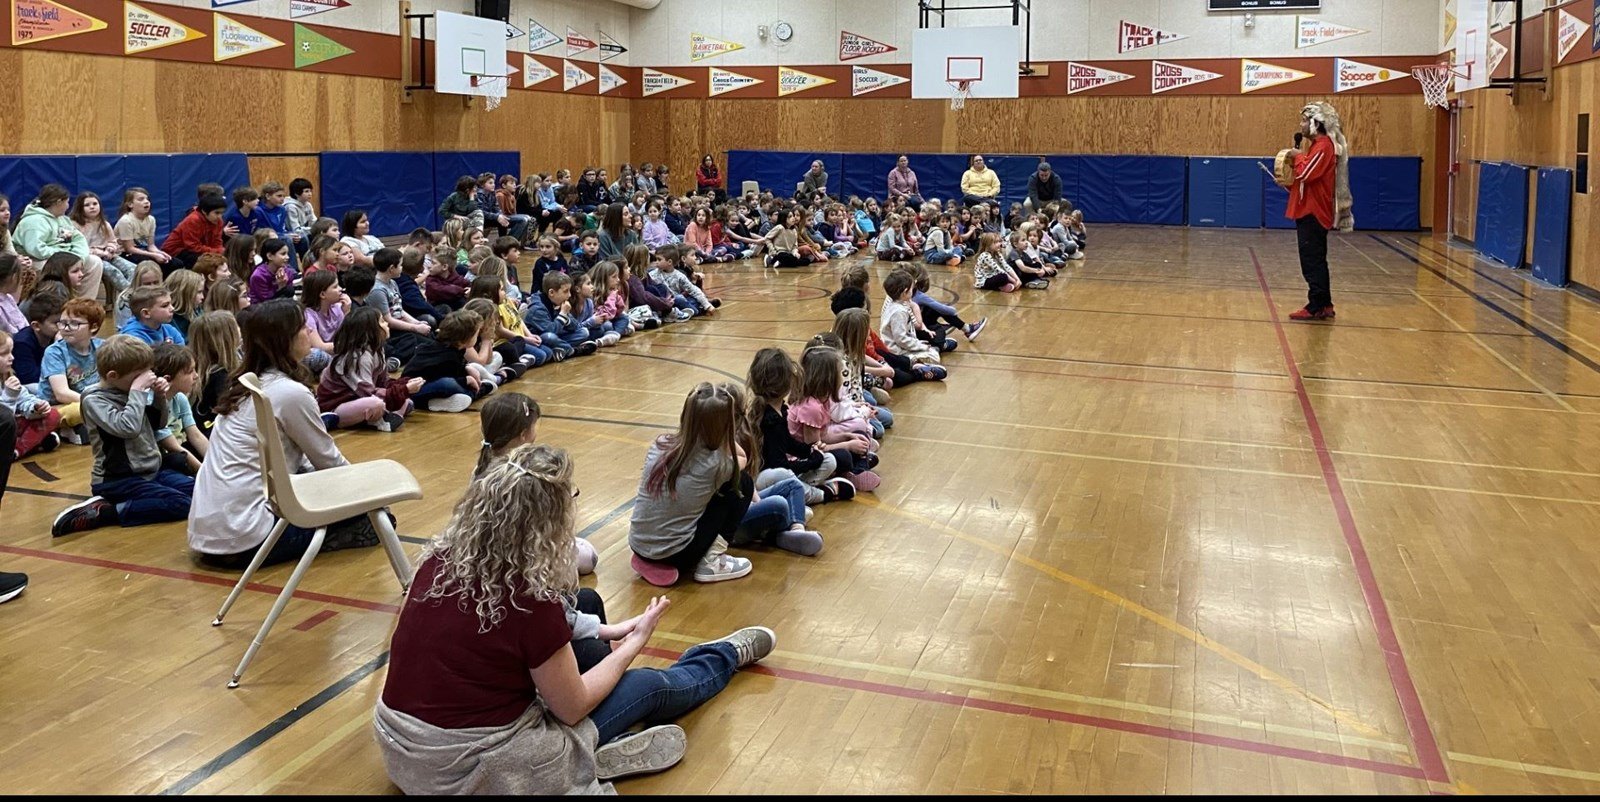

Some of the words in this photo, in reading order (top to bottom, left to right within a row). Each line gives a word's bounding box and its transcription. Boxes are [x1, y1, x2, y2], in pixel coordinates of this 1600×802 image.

[129, 22, 171, 38] SOCCER
[1124, 22, 1153, 36] TRACK
[693, 43, 728, 52] BASKETBALL
[1127, 37, 1153, 50] FIELD
[1070, 64, 1096, 78] CROSS
[1155, 63, 1182, 77] CROSS
[1254, 71, 1283, 79] CHAMPIONS
[1340, 70, 1376, 81] Soccer
[781, 76, 807, 84] SOCCER
[1070, 78, 1105, 91] COUNTRY
[1155, 77, 1192, 90] COUNTRY
